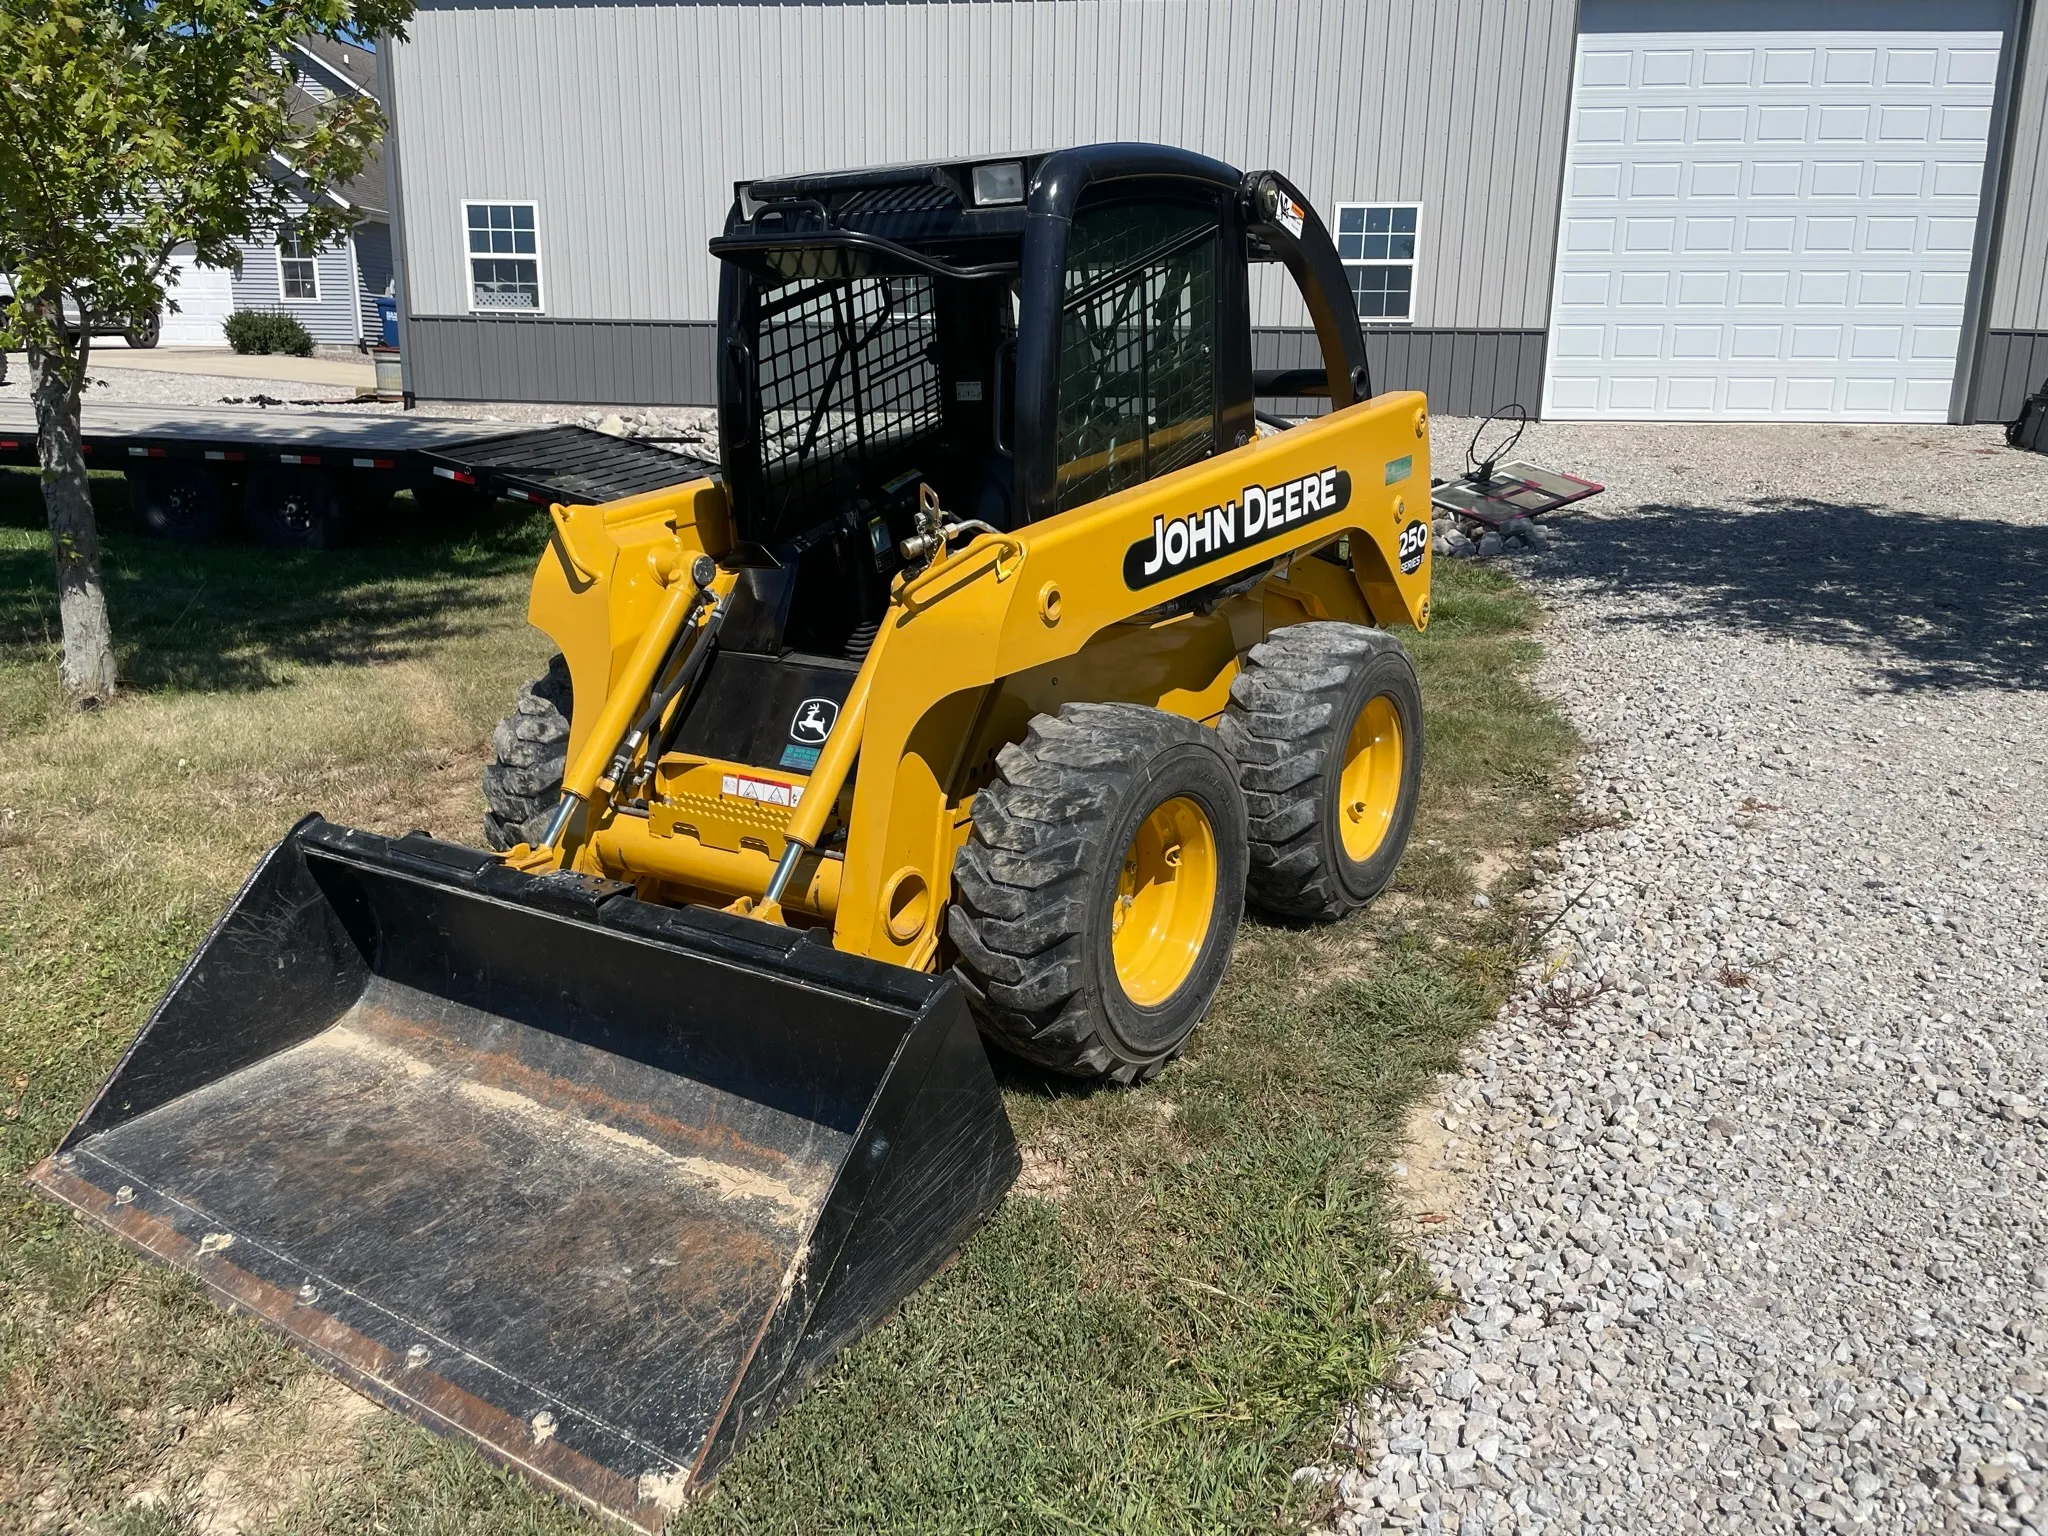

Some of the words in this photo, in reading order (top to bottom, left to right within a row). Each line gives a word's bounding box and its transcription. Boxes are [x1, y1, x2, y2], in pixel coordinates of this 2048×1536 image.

[1144, 503, 1236, 576] JOHN
[1243, 468, 1337, 538] DEERE
[1399, 523, 1428, 558] 250
[1400, 555, 1421, 573] SERIES
